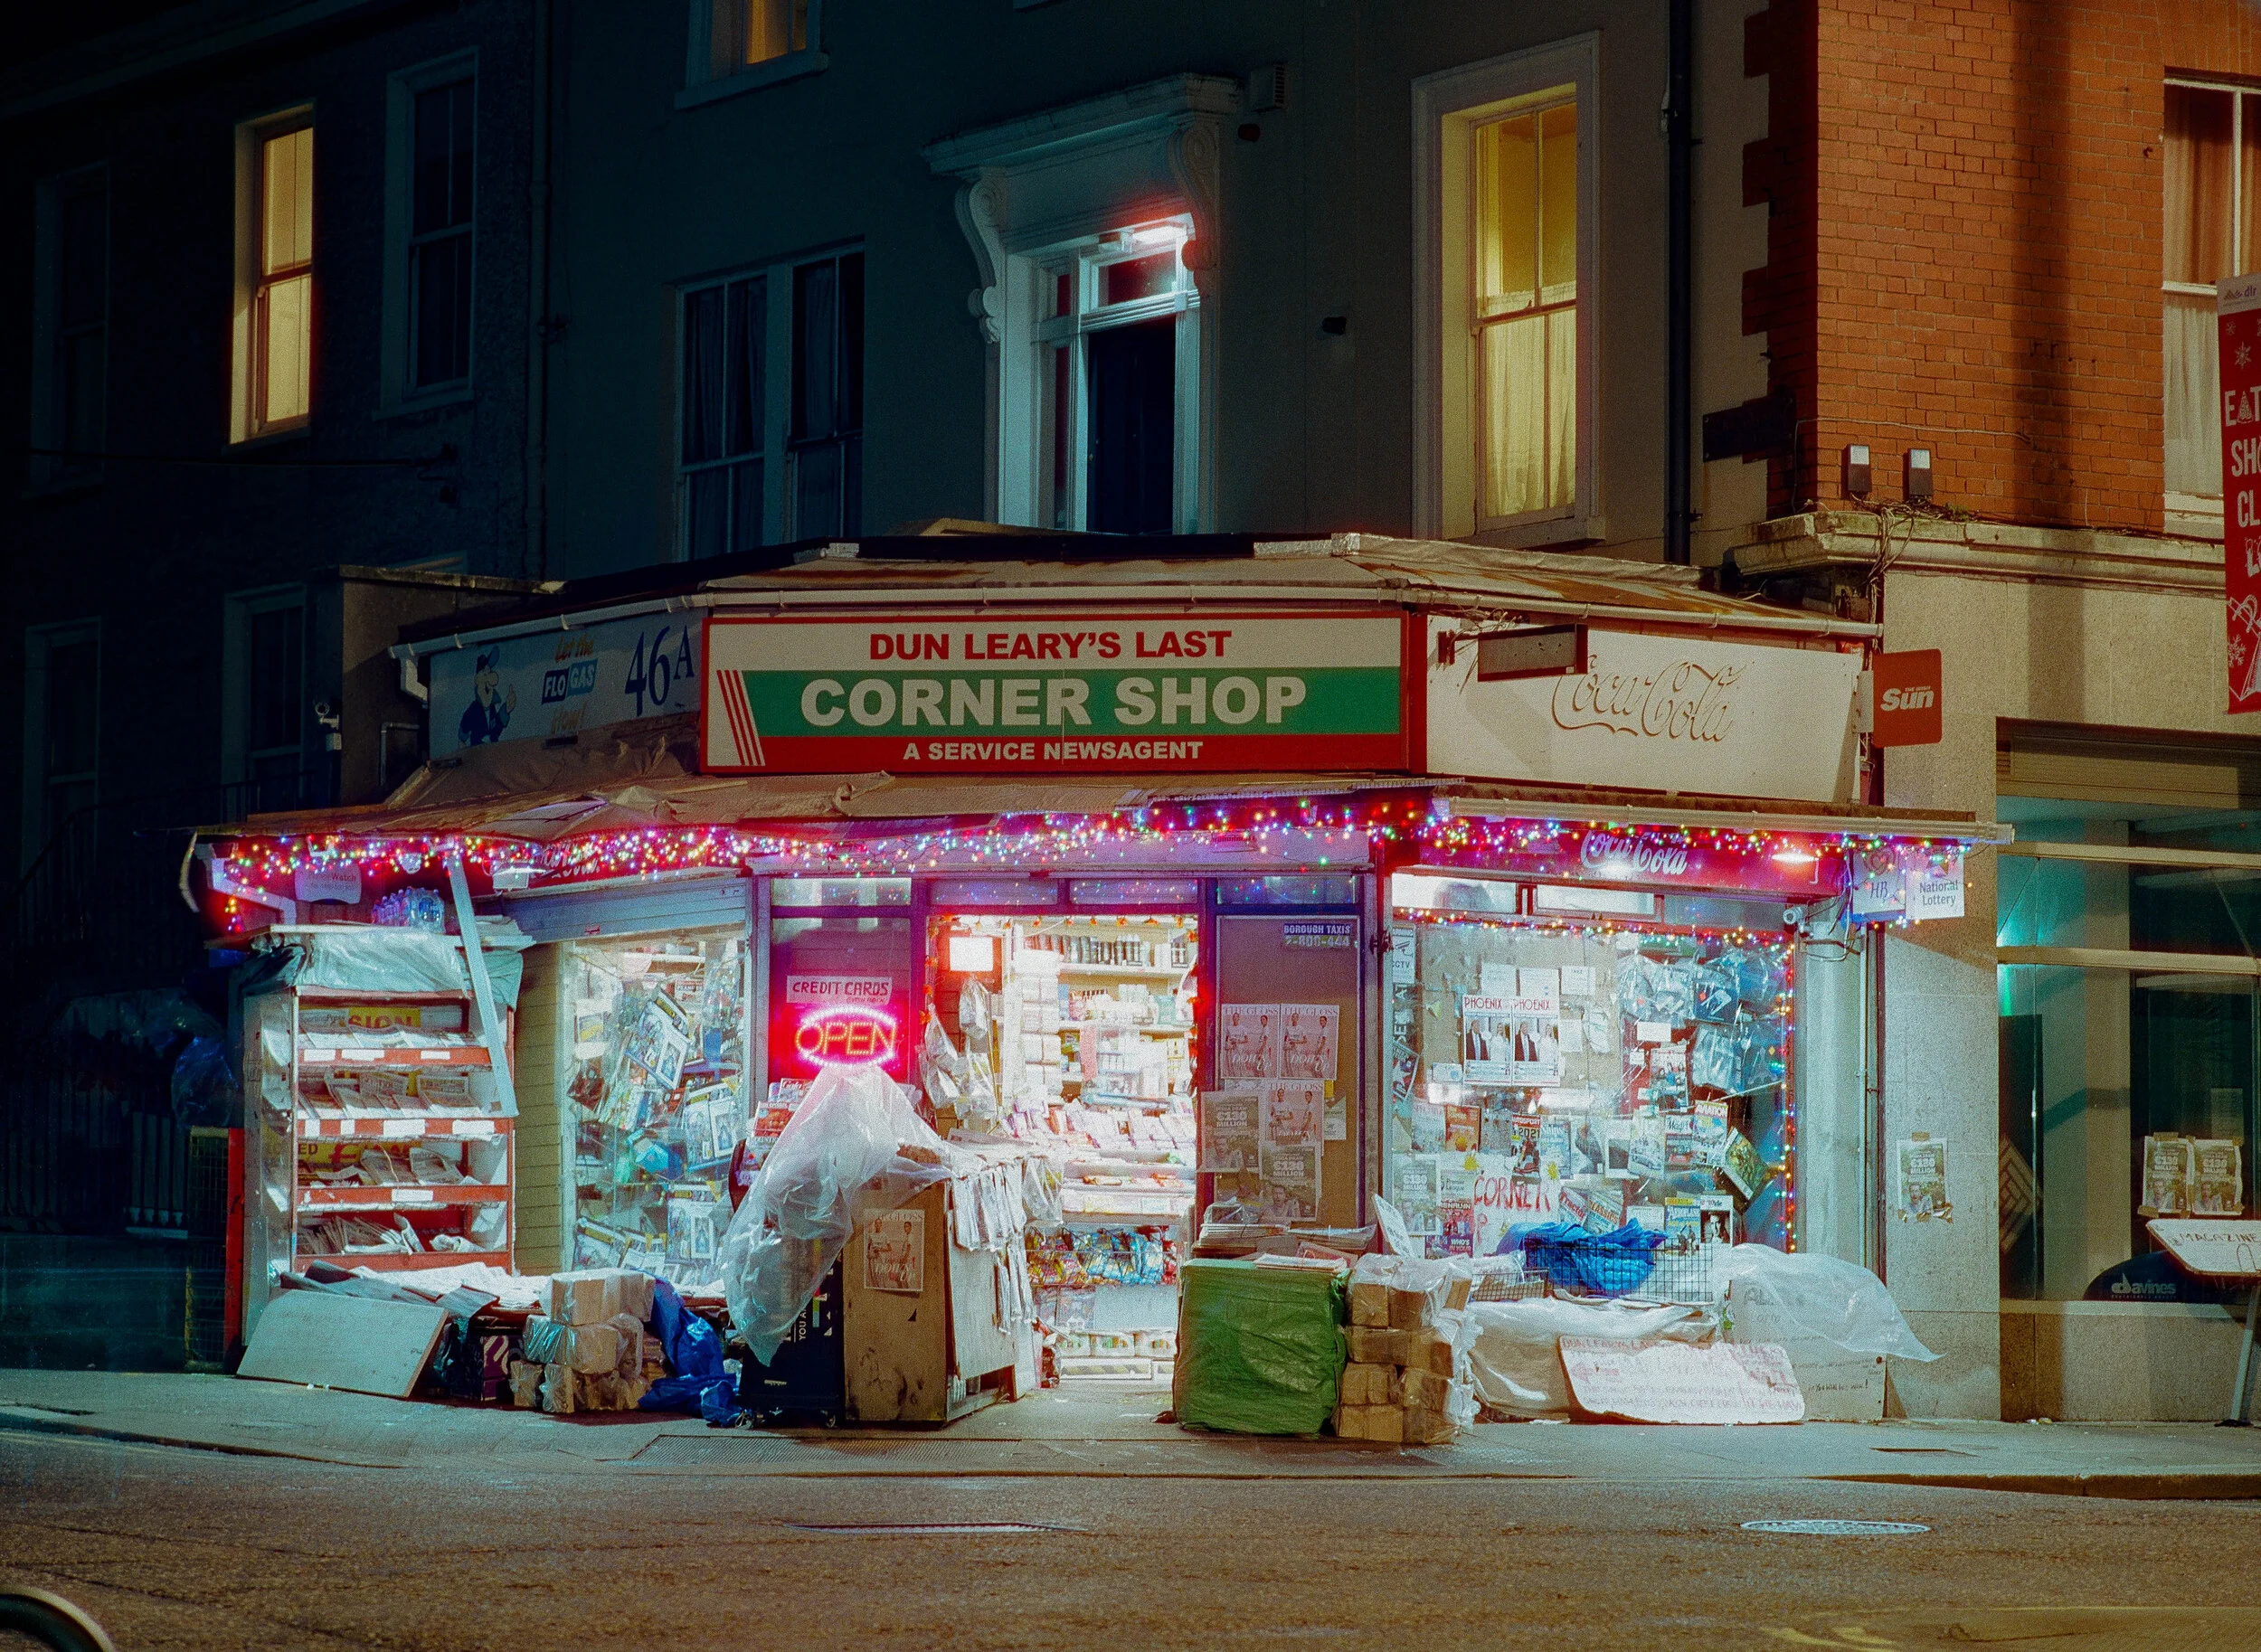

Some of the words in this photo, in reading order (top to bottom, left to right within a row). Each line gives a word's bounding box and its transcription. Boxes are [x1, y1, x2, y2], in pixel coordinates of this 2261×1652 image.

[869, 633, 950, 660] DUN
[963, 631, 1122, 661] LEARY'S
[1135, 629, 1233, 658] LAST
[624, 624, 695, 717] 46A
[799, 677, 1094, 727] CORNER
[1113, 675, 1307, 725] SHOP
[1551, 654, 1747, 742] Coca-Cola
[1880, 688, 1935, 712] Sun
[903, 743, 921, 760] A
[927, 741, 1040, 760] SERVICE
[1043, 740, 1204, 760] NEWSAGENT
[1869, 880, 1889, 900] HB
[1919, 879, 1959, 893] National
[1922, 894, 1956, 907] Lottery
[1283, 924, 1324, 935] BOROUGH
[1326, 924, 1351, 935] TAXIS
[792, 981, 842, 995] CREDIT
[844, 981, 889, 996] CARDS
[1464, 996, 1503, 1010] PHOENIX
[1513, 998, 1550, 1011] PHOENIX
[795, 1022, 897, 1055] OPEN
[1473, 1175, 1551, 1213] CORNER
[2111, 1273, 2177, 1295] davines
